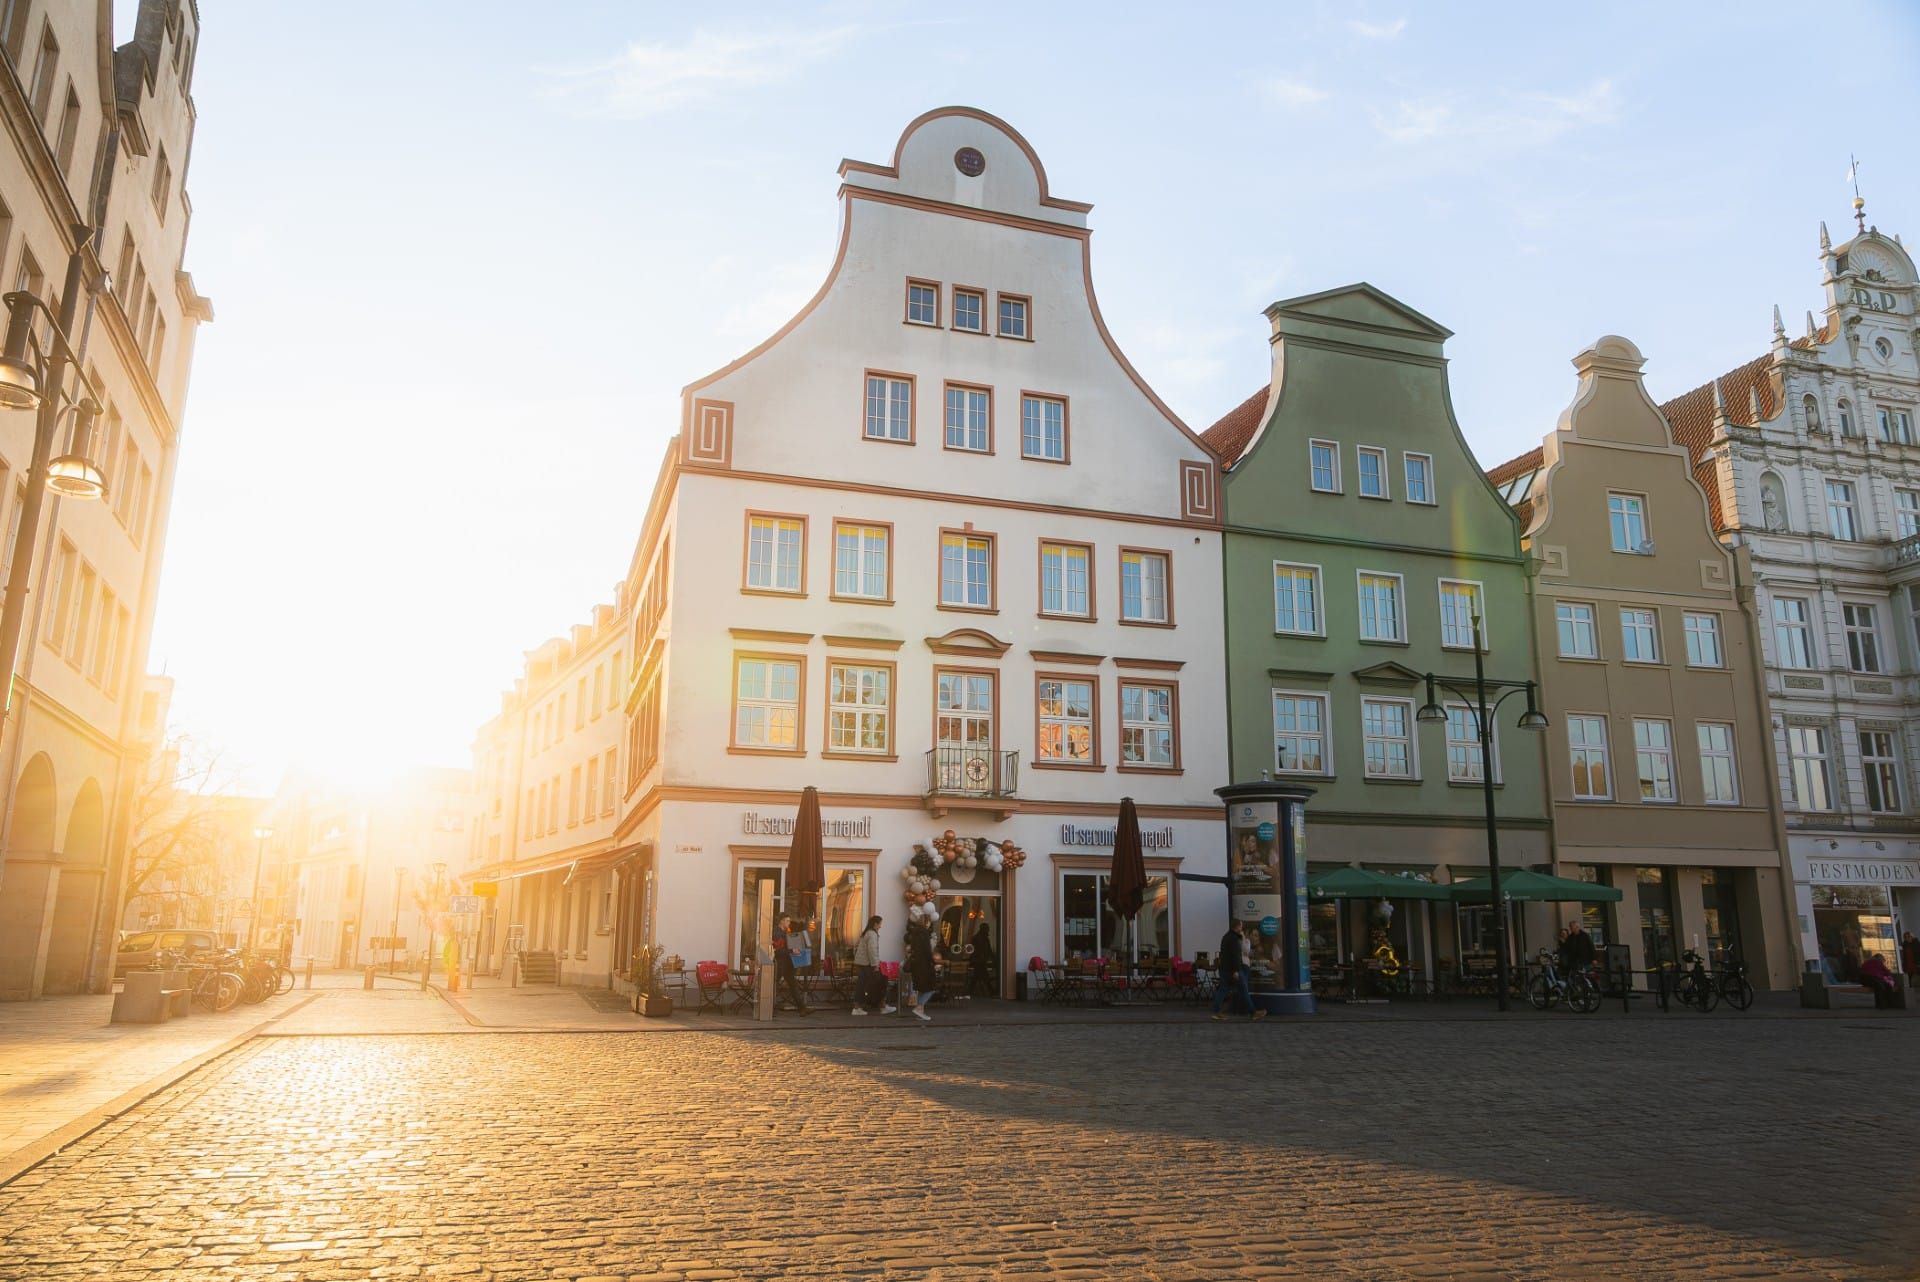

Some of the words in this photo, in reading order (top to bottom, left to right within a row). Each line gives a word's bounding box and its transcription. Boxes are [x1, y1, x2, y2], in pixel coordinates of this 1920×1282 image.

[744, 810, 758, 834] 60
[834, 815, 872, 841] napoli
[1062, 823, 1076, 845] 60
[1078, 823, 1117, 845] second
[1140, 825, 1173, 851] napoli
[1809, 863, 1915, 881] FESTMODEN
